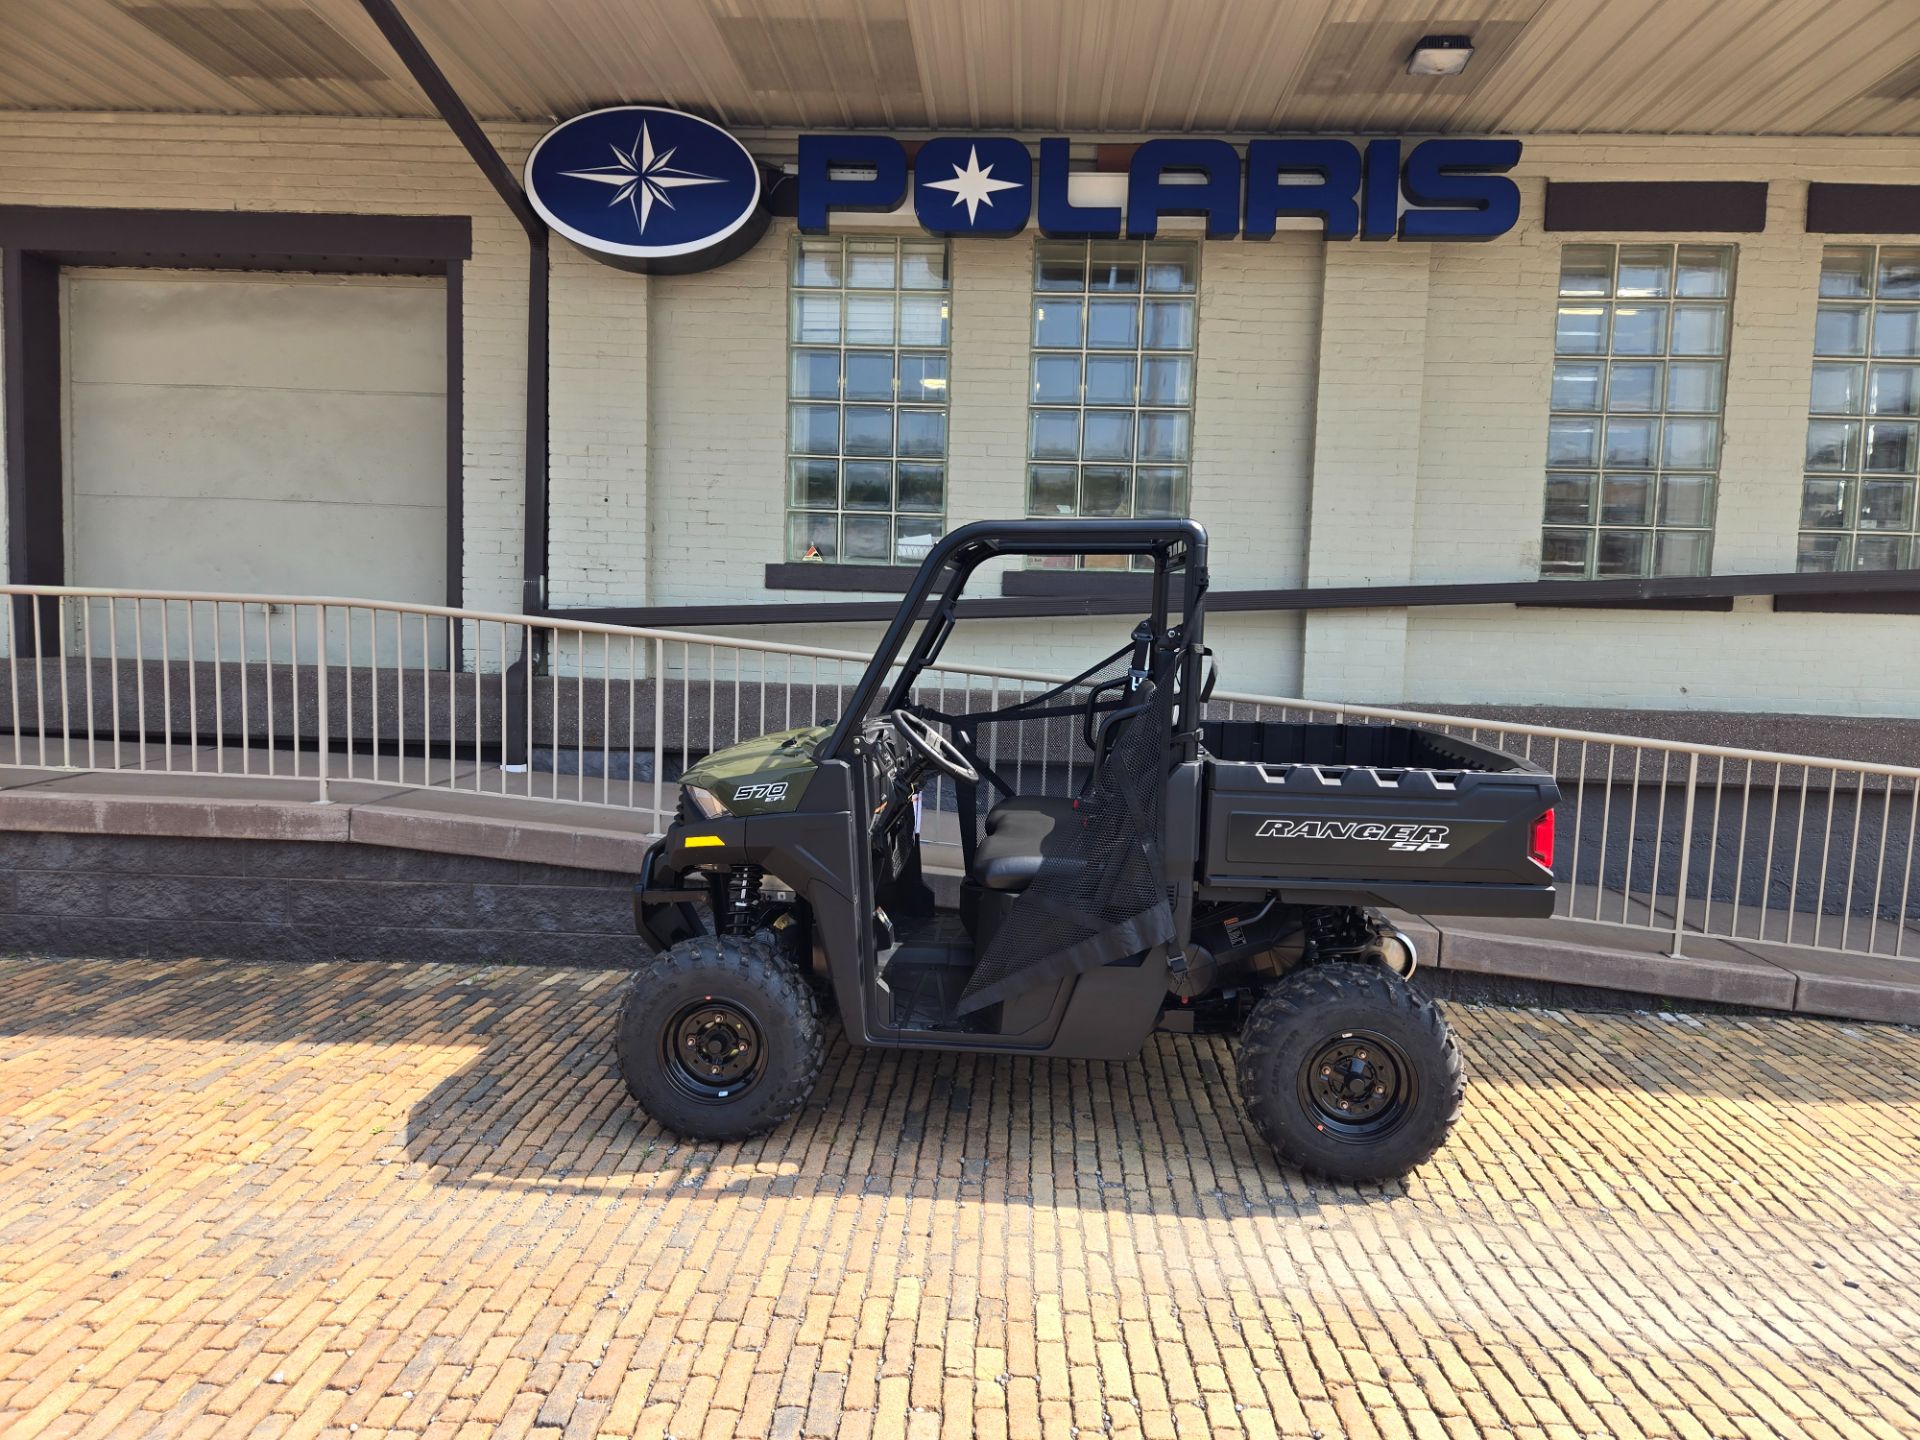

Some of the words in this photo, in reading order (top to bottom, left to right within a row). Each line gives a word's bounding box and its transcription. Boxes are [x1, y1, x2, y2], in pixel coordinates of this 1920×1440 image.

[799, 135, 1522, 241] POLARIS
[733, 781, 788, 801] 570
[1255, 820, 1450, 843] RANGER
[1388, 842, 1451, 852] SP
